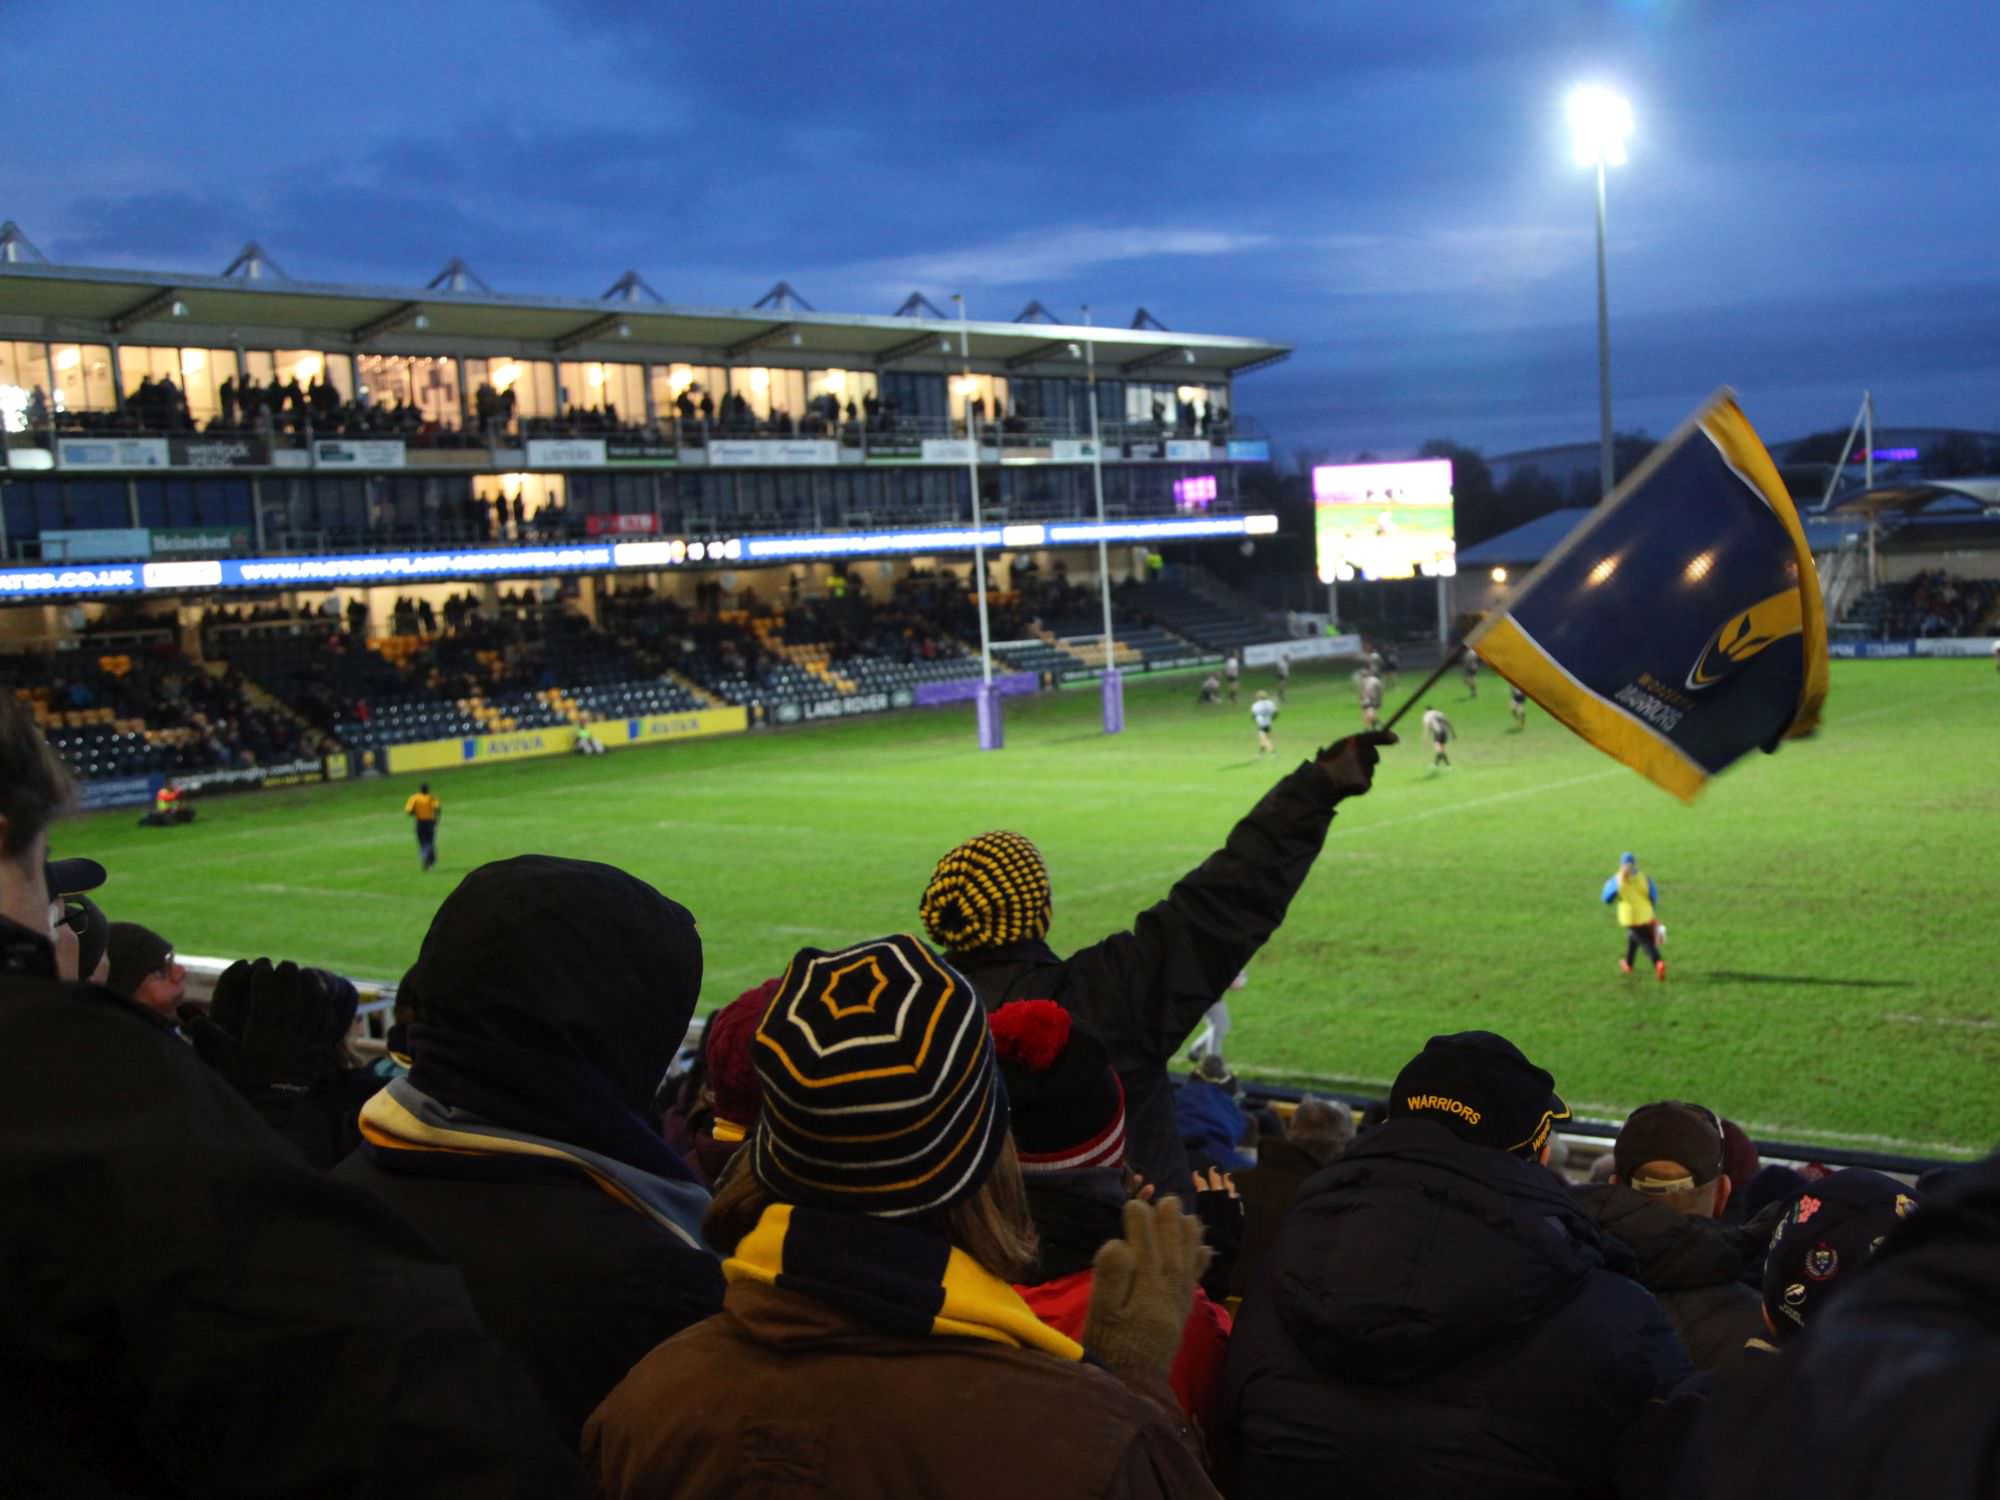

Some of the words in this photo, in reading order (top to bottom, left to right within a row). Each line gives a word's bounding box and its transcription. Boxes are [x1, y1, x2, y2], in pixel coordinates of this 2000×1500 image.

[153, 533, 231, 552] Heineken
[803, 699, 842, 719] LAND
[844, 693, 888, 714] ROVER
[489, 736, 545, 753] AVIVA
[1407, 1094, 1481, 1125] WARRIORS
